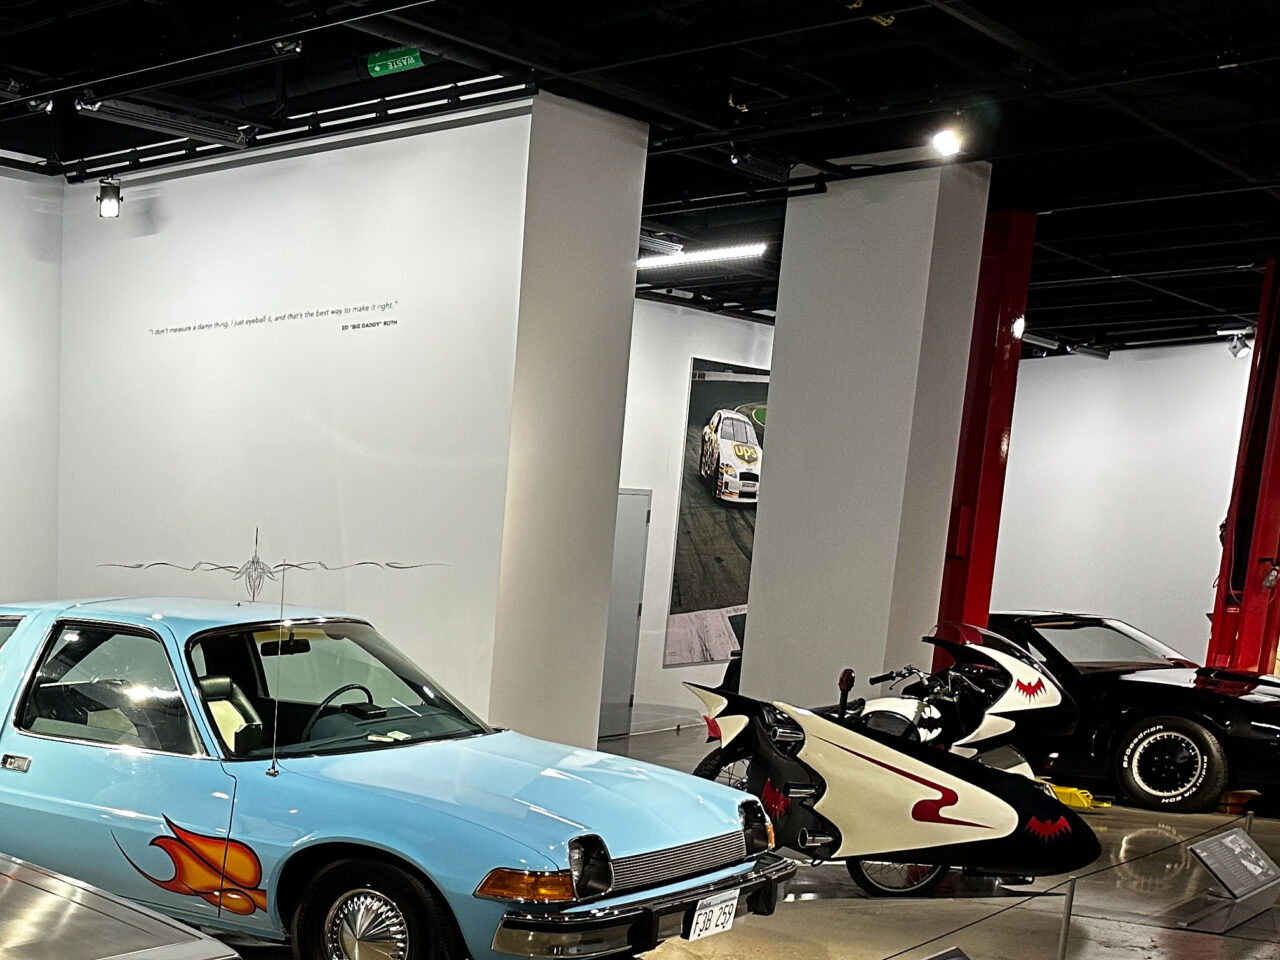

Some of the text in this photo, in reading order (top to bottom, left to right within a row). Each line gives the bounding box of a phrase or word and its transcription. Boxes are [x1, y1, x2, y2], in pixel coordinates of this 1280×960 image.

[388, 56, 415, 70] WASTE
[245, 316, 266, 325] eyeball
[1122, 725, 1163, 768] BFGoodrich
[714, 903, 734, 928] 259
